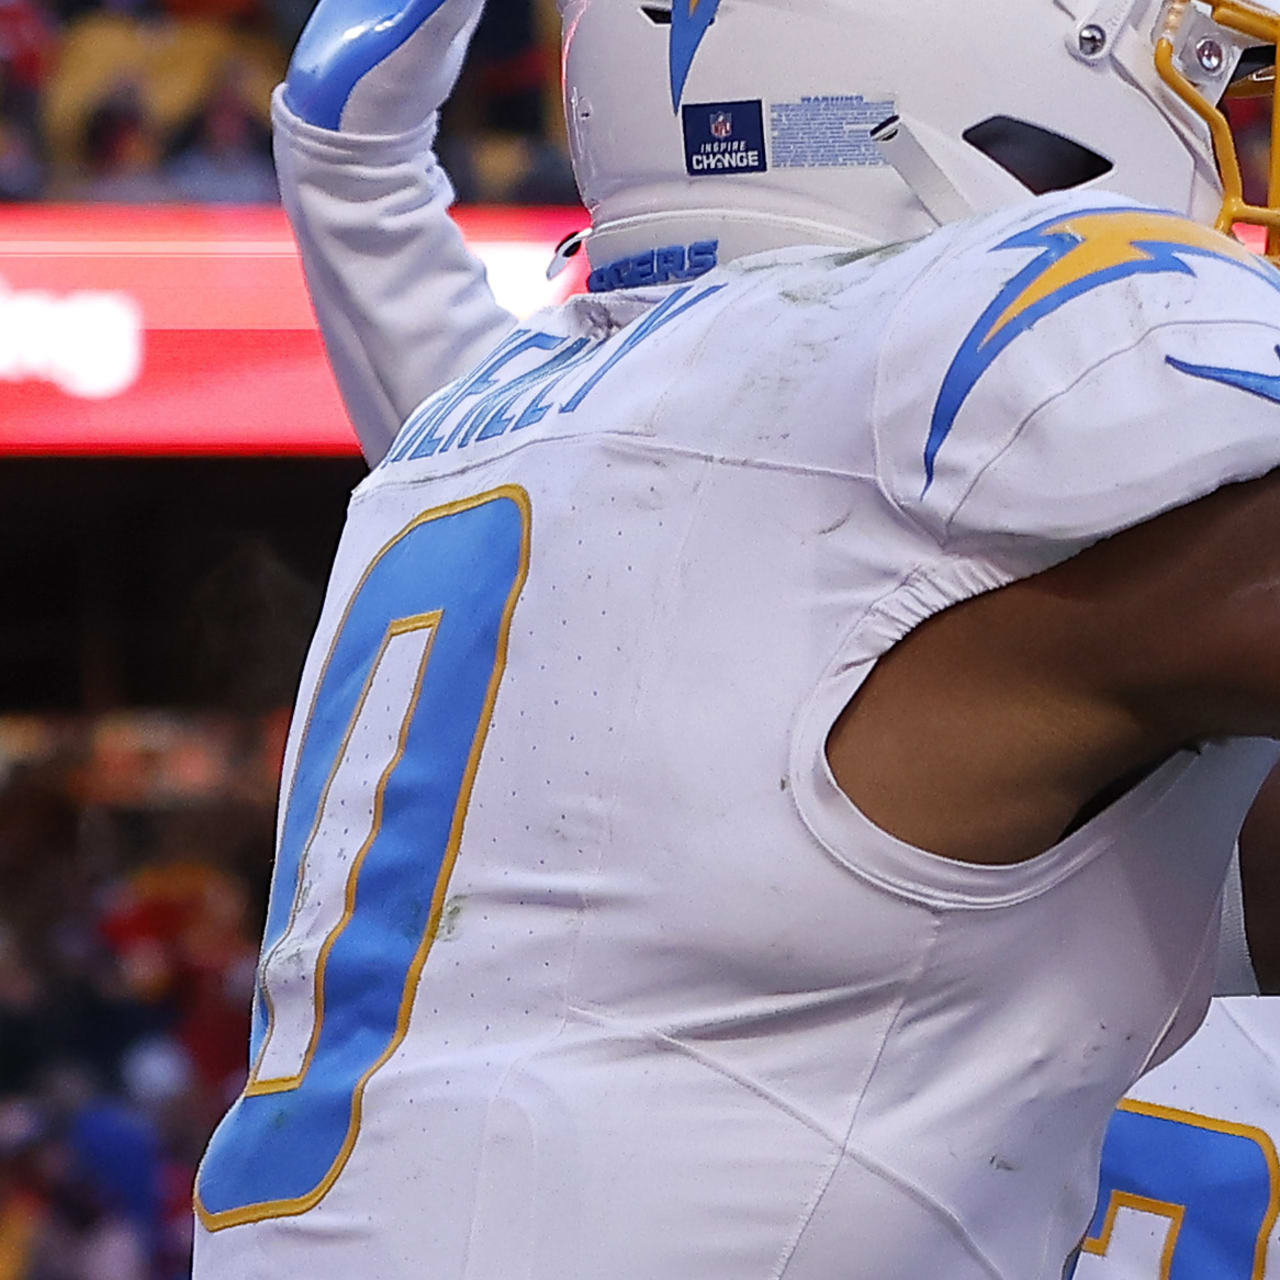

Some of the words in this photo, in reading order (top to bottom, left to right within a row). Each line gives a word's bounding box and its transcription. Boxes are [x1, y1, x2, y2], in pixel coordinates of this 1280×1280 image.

[701, 140, 746, 153] INSPIRE
[692, 151, 759, 169] CHANGE
[193, 484, 531, 1233] 0
